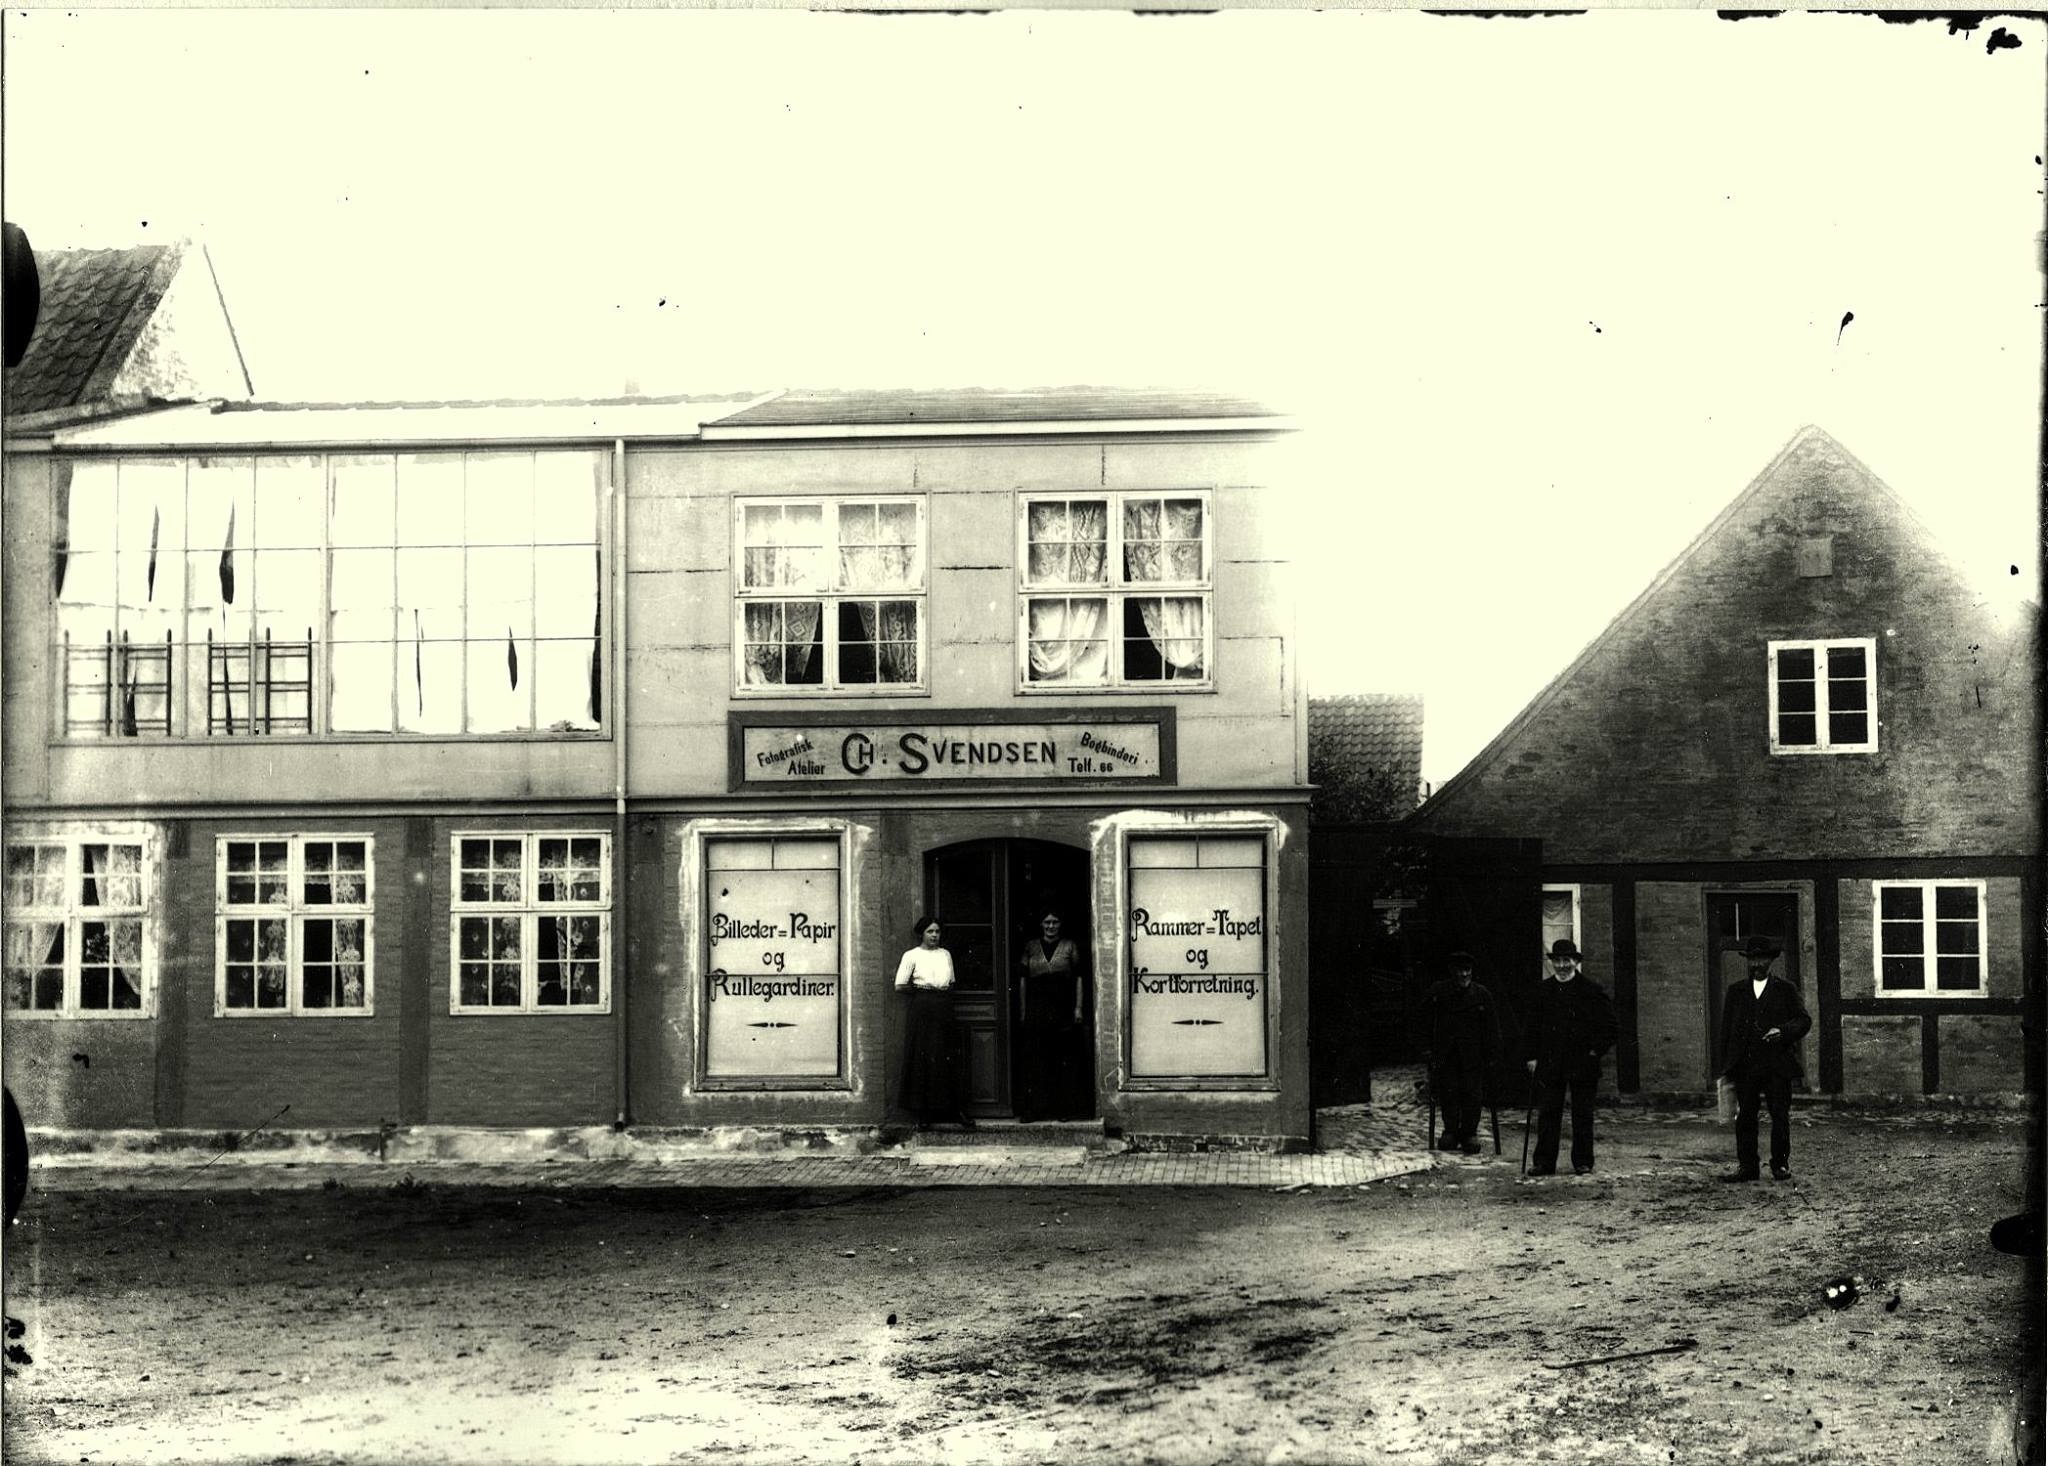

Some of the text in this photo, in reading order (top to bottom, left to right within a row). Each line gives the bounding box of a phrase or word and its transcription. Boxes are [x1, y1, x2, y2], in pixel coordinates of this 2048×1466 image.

[757, 739, 814, 767] Fotografisk
[899, 732, 1057, 775] SVENDSEN
[788, 761, 826, 775] Atelier
[762, 951, 785, 972] og
[1186, 949, 1208, 969] og
[710, 968, 835, 1003] Rullegardiner.
